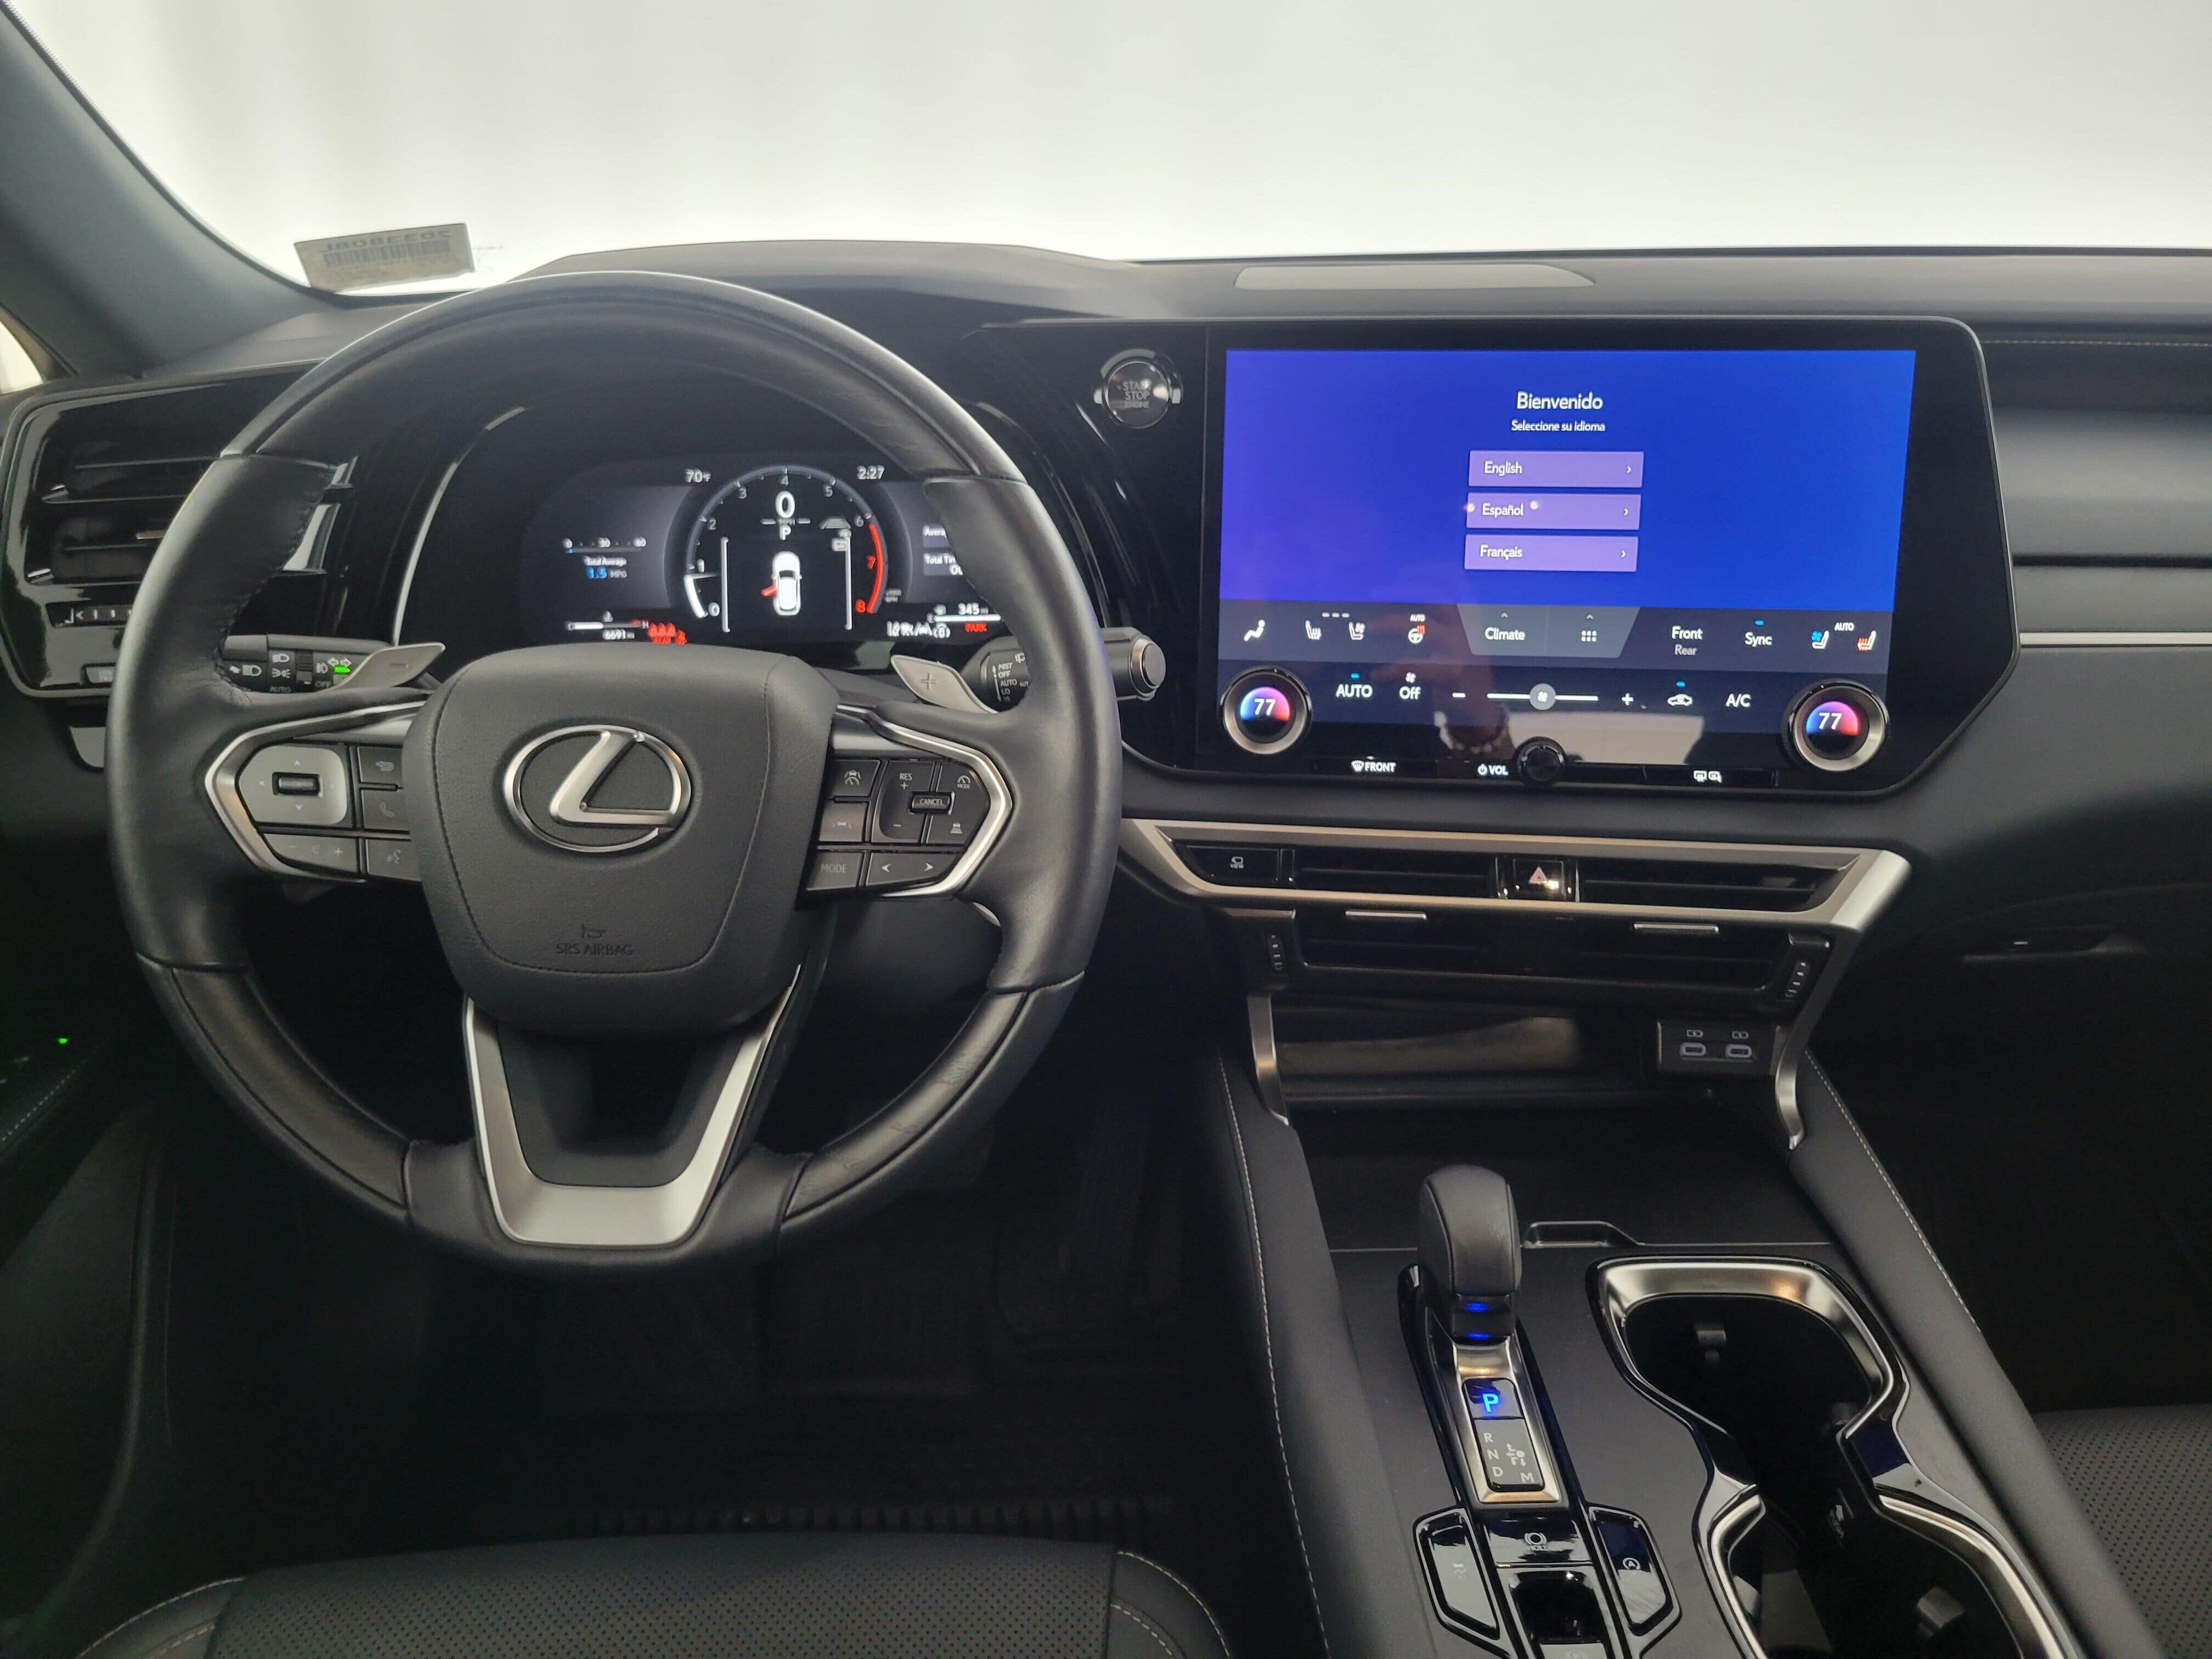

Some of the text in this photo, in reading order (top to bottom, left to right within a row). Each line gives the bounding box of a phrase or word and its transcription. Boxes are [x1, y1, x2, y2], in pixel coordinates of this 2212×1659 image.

[1125, 392, 1150, 400] STOP
[1517, 391, 1603, 409] Bienvenido
[1511, 419, 1605, 431] Seleccione su idioma
[857, 465, 885, 480] 2:27
[1484, 460, 1522, 476] English
[738, 487, 747, 499] 3
[775, 490, 795, 518] 0
[1482, 502, 1523, 518] Español
[707, 517, 716, 530] 2
[855, 514, 864, 527] 6
[779, 524, 792, 540] P
[923, 525, 947, 538] Avera
[923, 553, 943, 564] Total
[1480, 544, 1523, 560] Français
[708, 601, 720, 617] 0
[855, 599, 866, 613] 8
[958, 602, 980, 615] 345
[1410, 614, 1426, 622] AUTO
[1672, 626, 1703, 640] Front
[1834, 622, 1854, 631] AUTO
[1485, 627, 1525, 641] Climate
[1745, 631, 1773, 647] Sync
[1675, 644, 1697, 656] Rear
[1000, 679, 1018, 687] AUTO
[1336, 684, 1373, 698] AUTO
[1400, 686, 1421, 699] Off
[1254, 698, 1276, 715] 77
[1725, 693, 1751, 708] A/C
[1819, 712, 1842, 730] 77
[1364, 761, 1397, 773] FRONT
[1488, 765, 1509, 775] VOL
[821, 863, 847, 873] MODE
[556, 943, 633, 955] SRS AIRBAG
[1482, 1393, 1499, 1413] P
[1483, 1432, 1494, 1443] R
[1487, 1449, 1499, 1460] N
[1492, 1466, 1503, 1477] D
[1520, 1472, 1534, 1483] M
